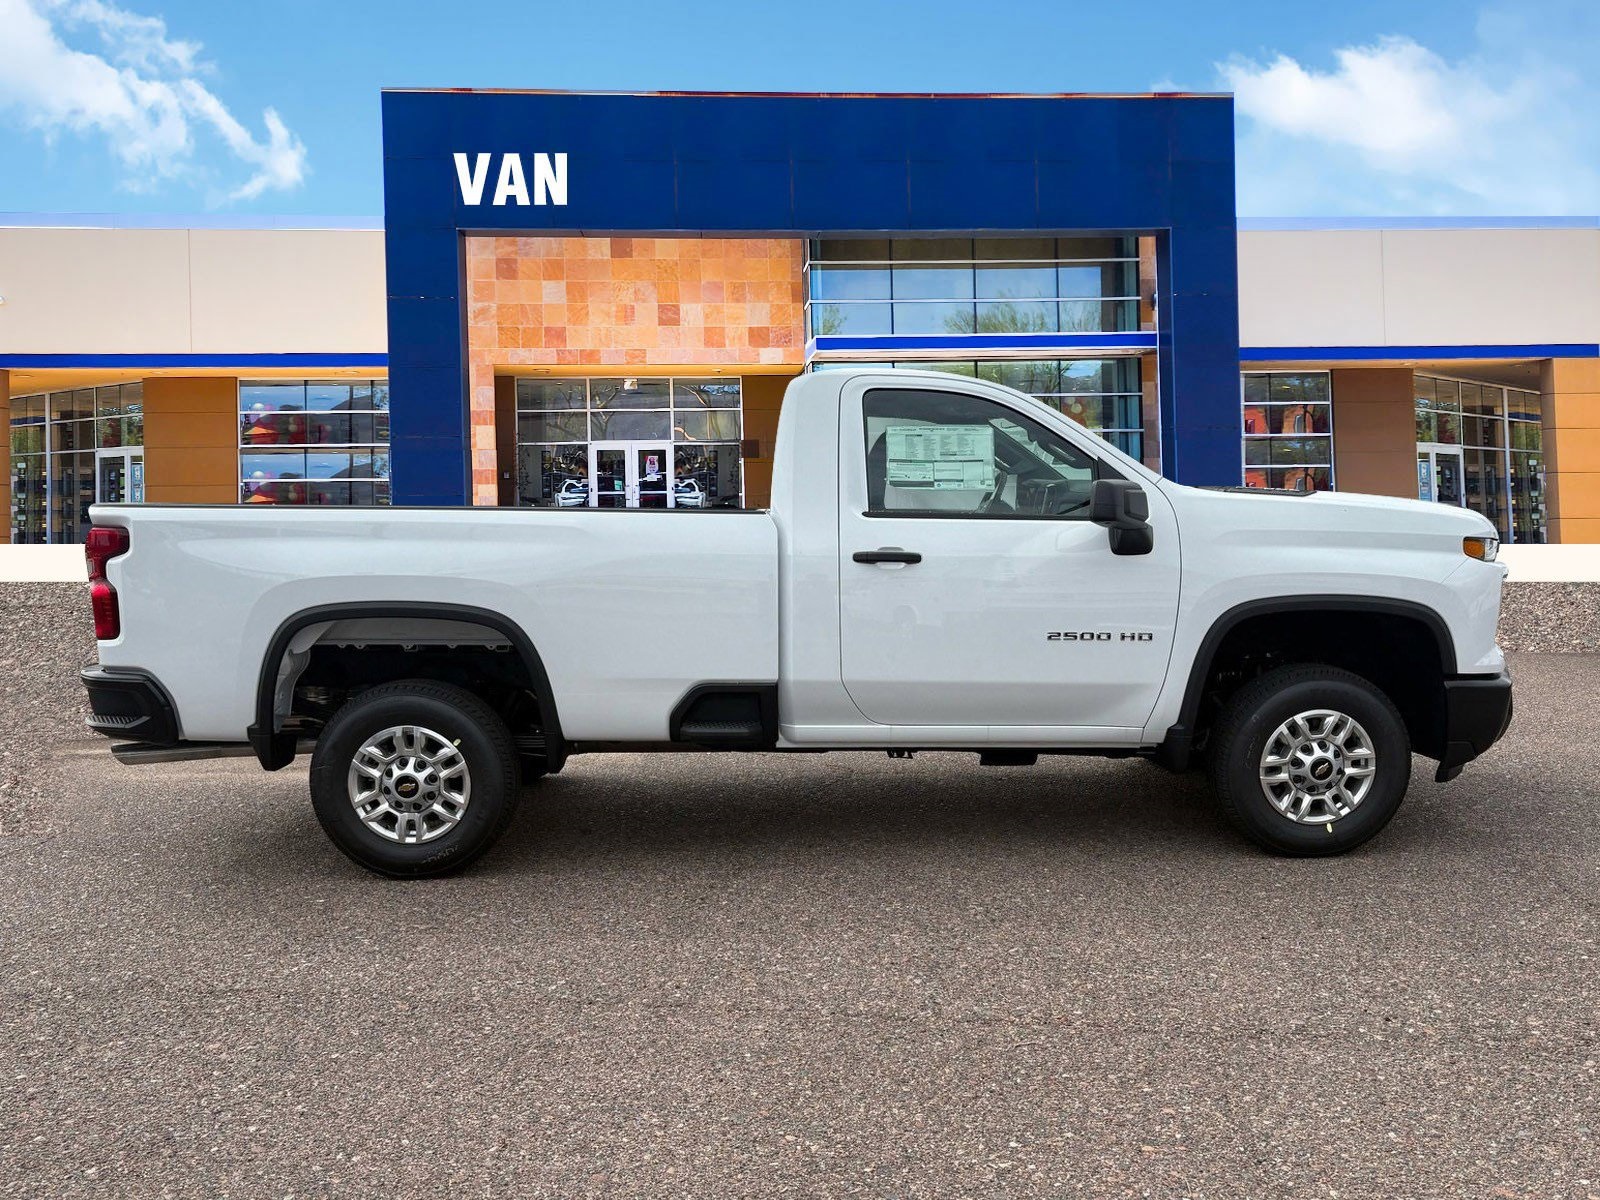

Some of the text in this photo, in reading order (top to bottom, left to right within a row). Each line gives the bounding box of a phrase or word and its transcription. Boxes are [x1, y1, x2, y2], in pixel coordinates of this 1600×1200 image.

[453, 153, 568, 205] VAN
[1047, 631, 1153, 641] 2500 HD
